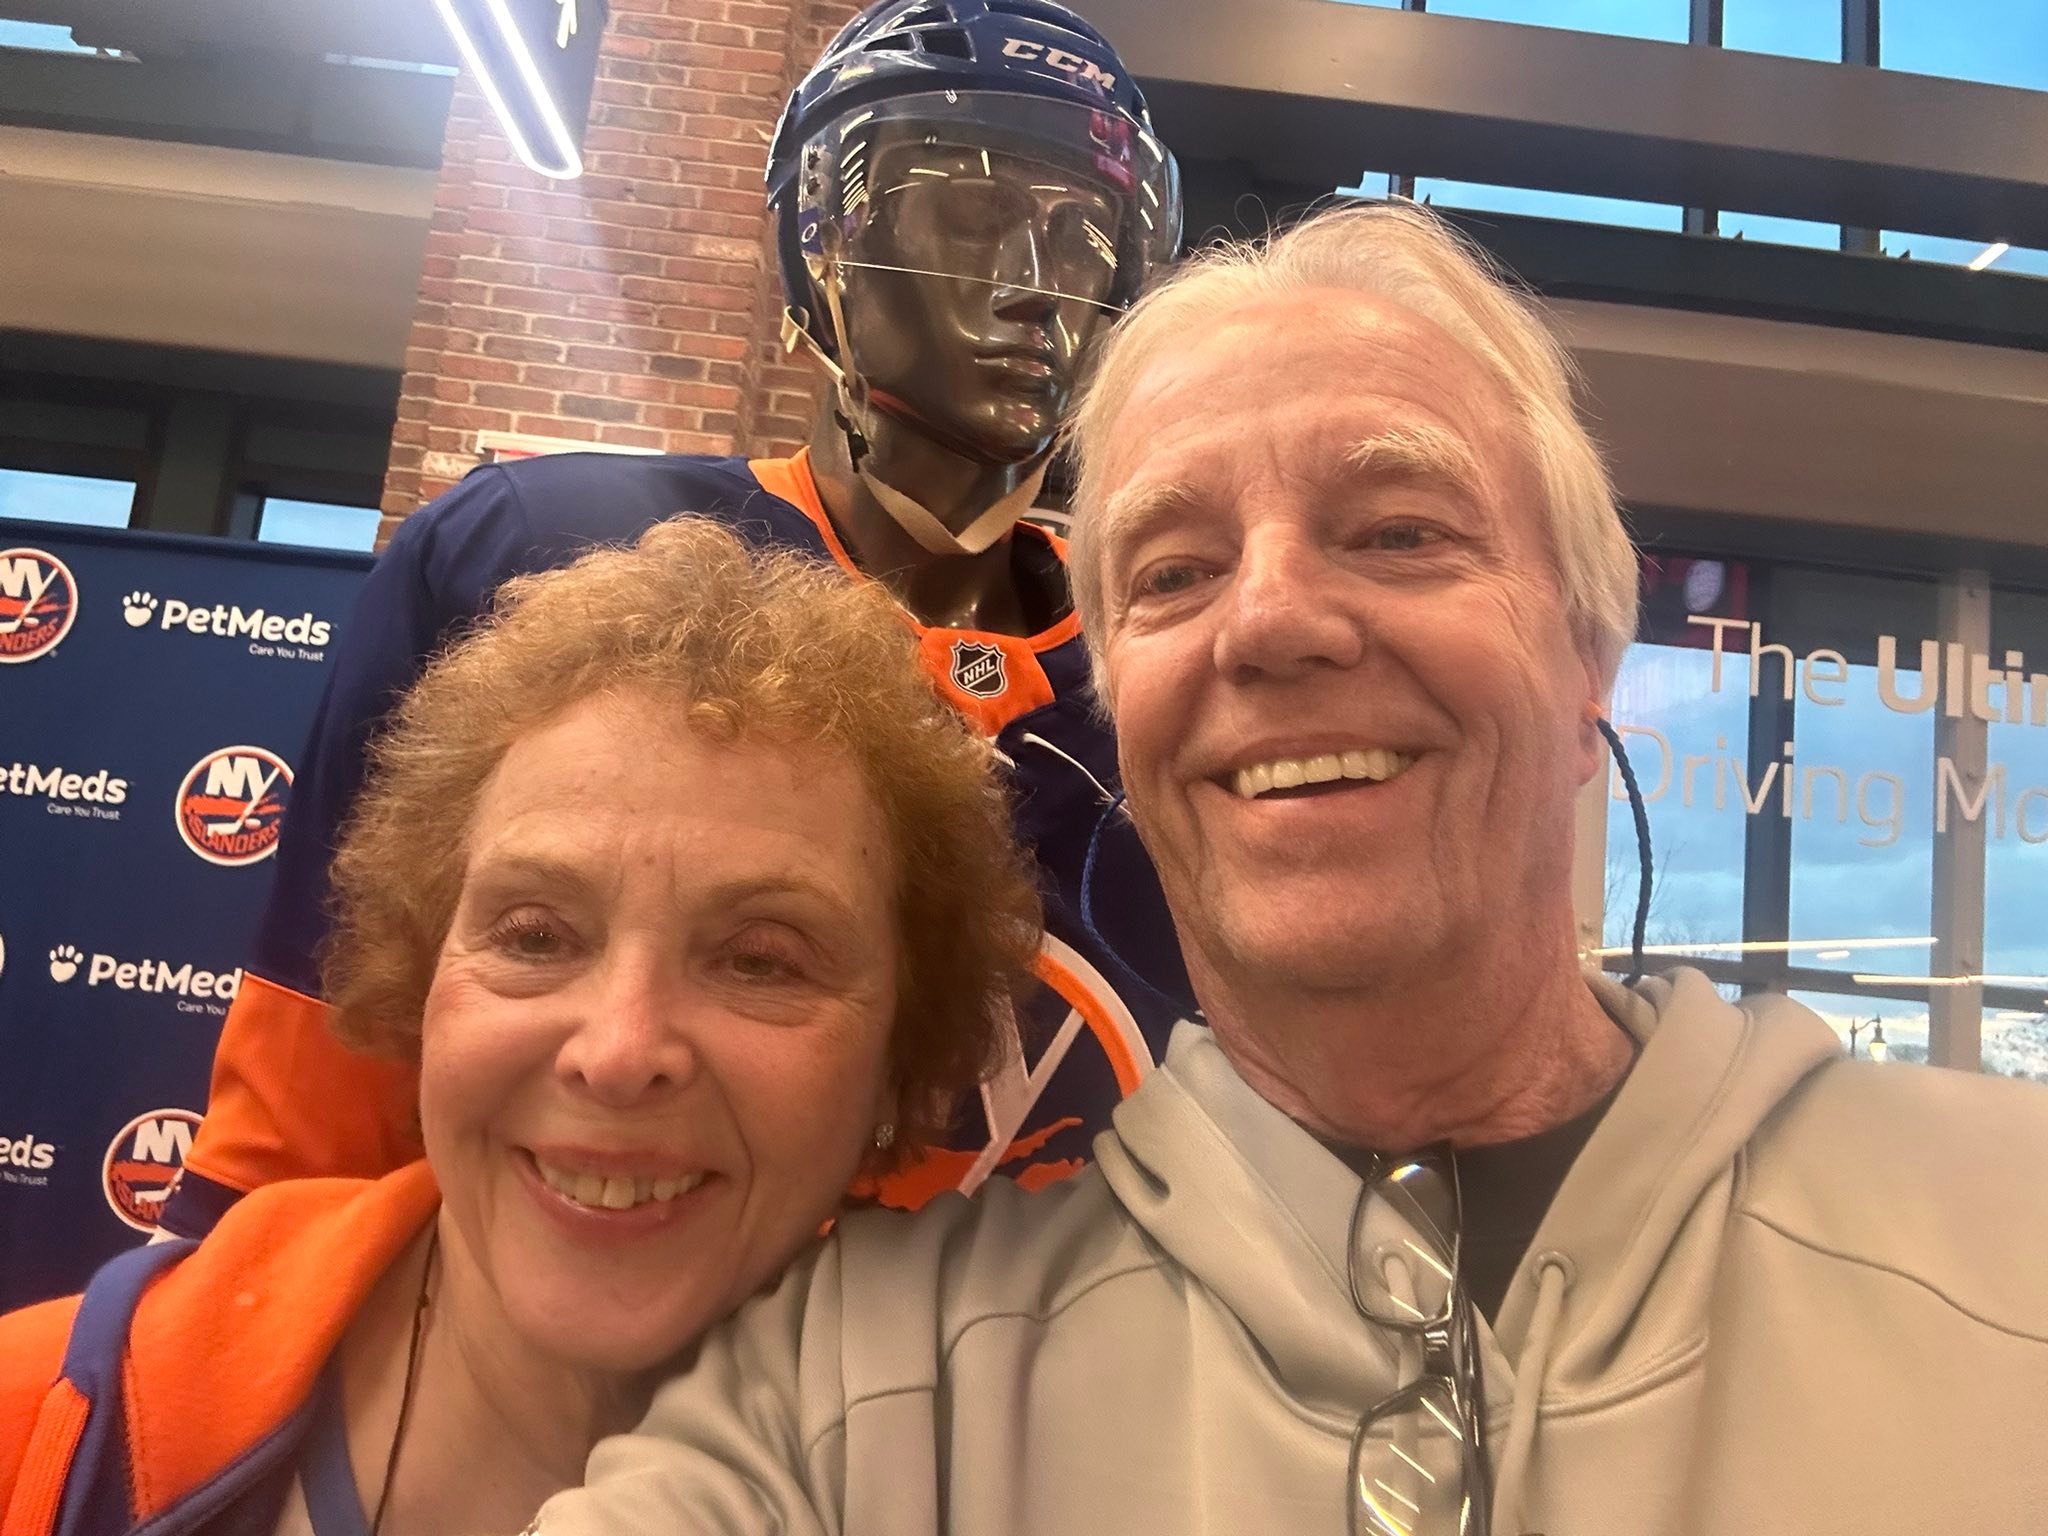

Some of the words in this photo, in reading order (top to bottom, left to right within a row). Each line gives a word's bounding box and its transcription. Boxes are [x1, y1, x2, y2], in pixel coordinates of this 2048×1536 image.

[1001, 37, 1115, 91] CCM
[0, 617, 59, 653] NDERS
[161, 599, 332, 646] PetMeds
[249, 643, 275, 656] Care
[277, 646, 296, 659] You
[298, 648, 325, 662] Trust
[1687, 614, 1848, 706] The
[1878, 635, 2048, 727] Ulti
[963, 658, 995, 685] NHL
[205, 756, 280, 803] NY
[1612, 725, 1904, 848] Driving
[47, 802, 72, 816] Care
[74, 805, 91, 818] You
[92, 806, 121, 820] Trust
[177, 1001, 203, 1014] Care
[206, 1004, 227, 1016] You
[20, 1173, 48, 1186] Trust
